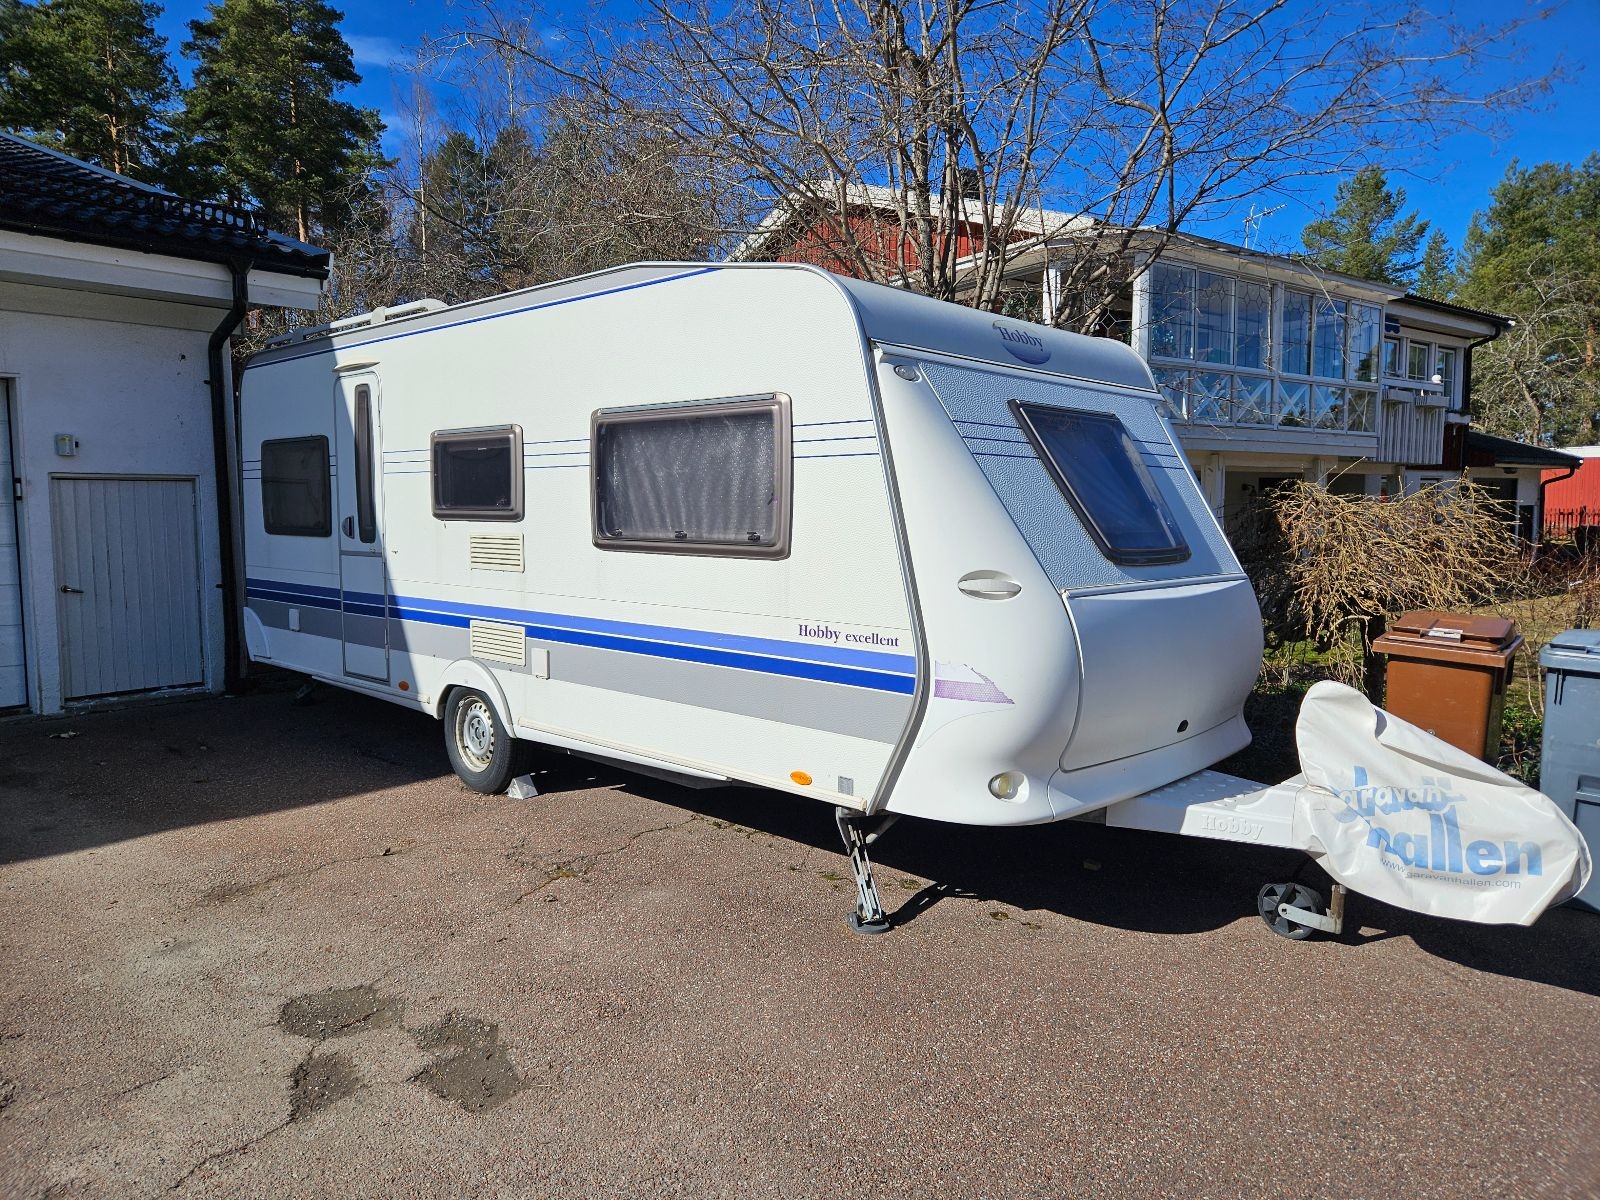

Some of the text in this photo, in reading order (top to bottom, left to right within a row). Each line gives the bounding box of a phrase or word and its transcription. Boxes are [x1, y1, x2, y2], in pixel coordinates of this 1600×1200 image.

[998, 326, 1044, 352] Hobby
[798, 624, 899, 647] Hobby excellent
[1335, 785, 1444, 813] aravan
[1201, 815, 1264, 841] Hobby
